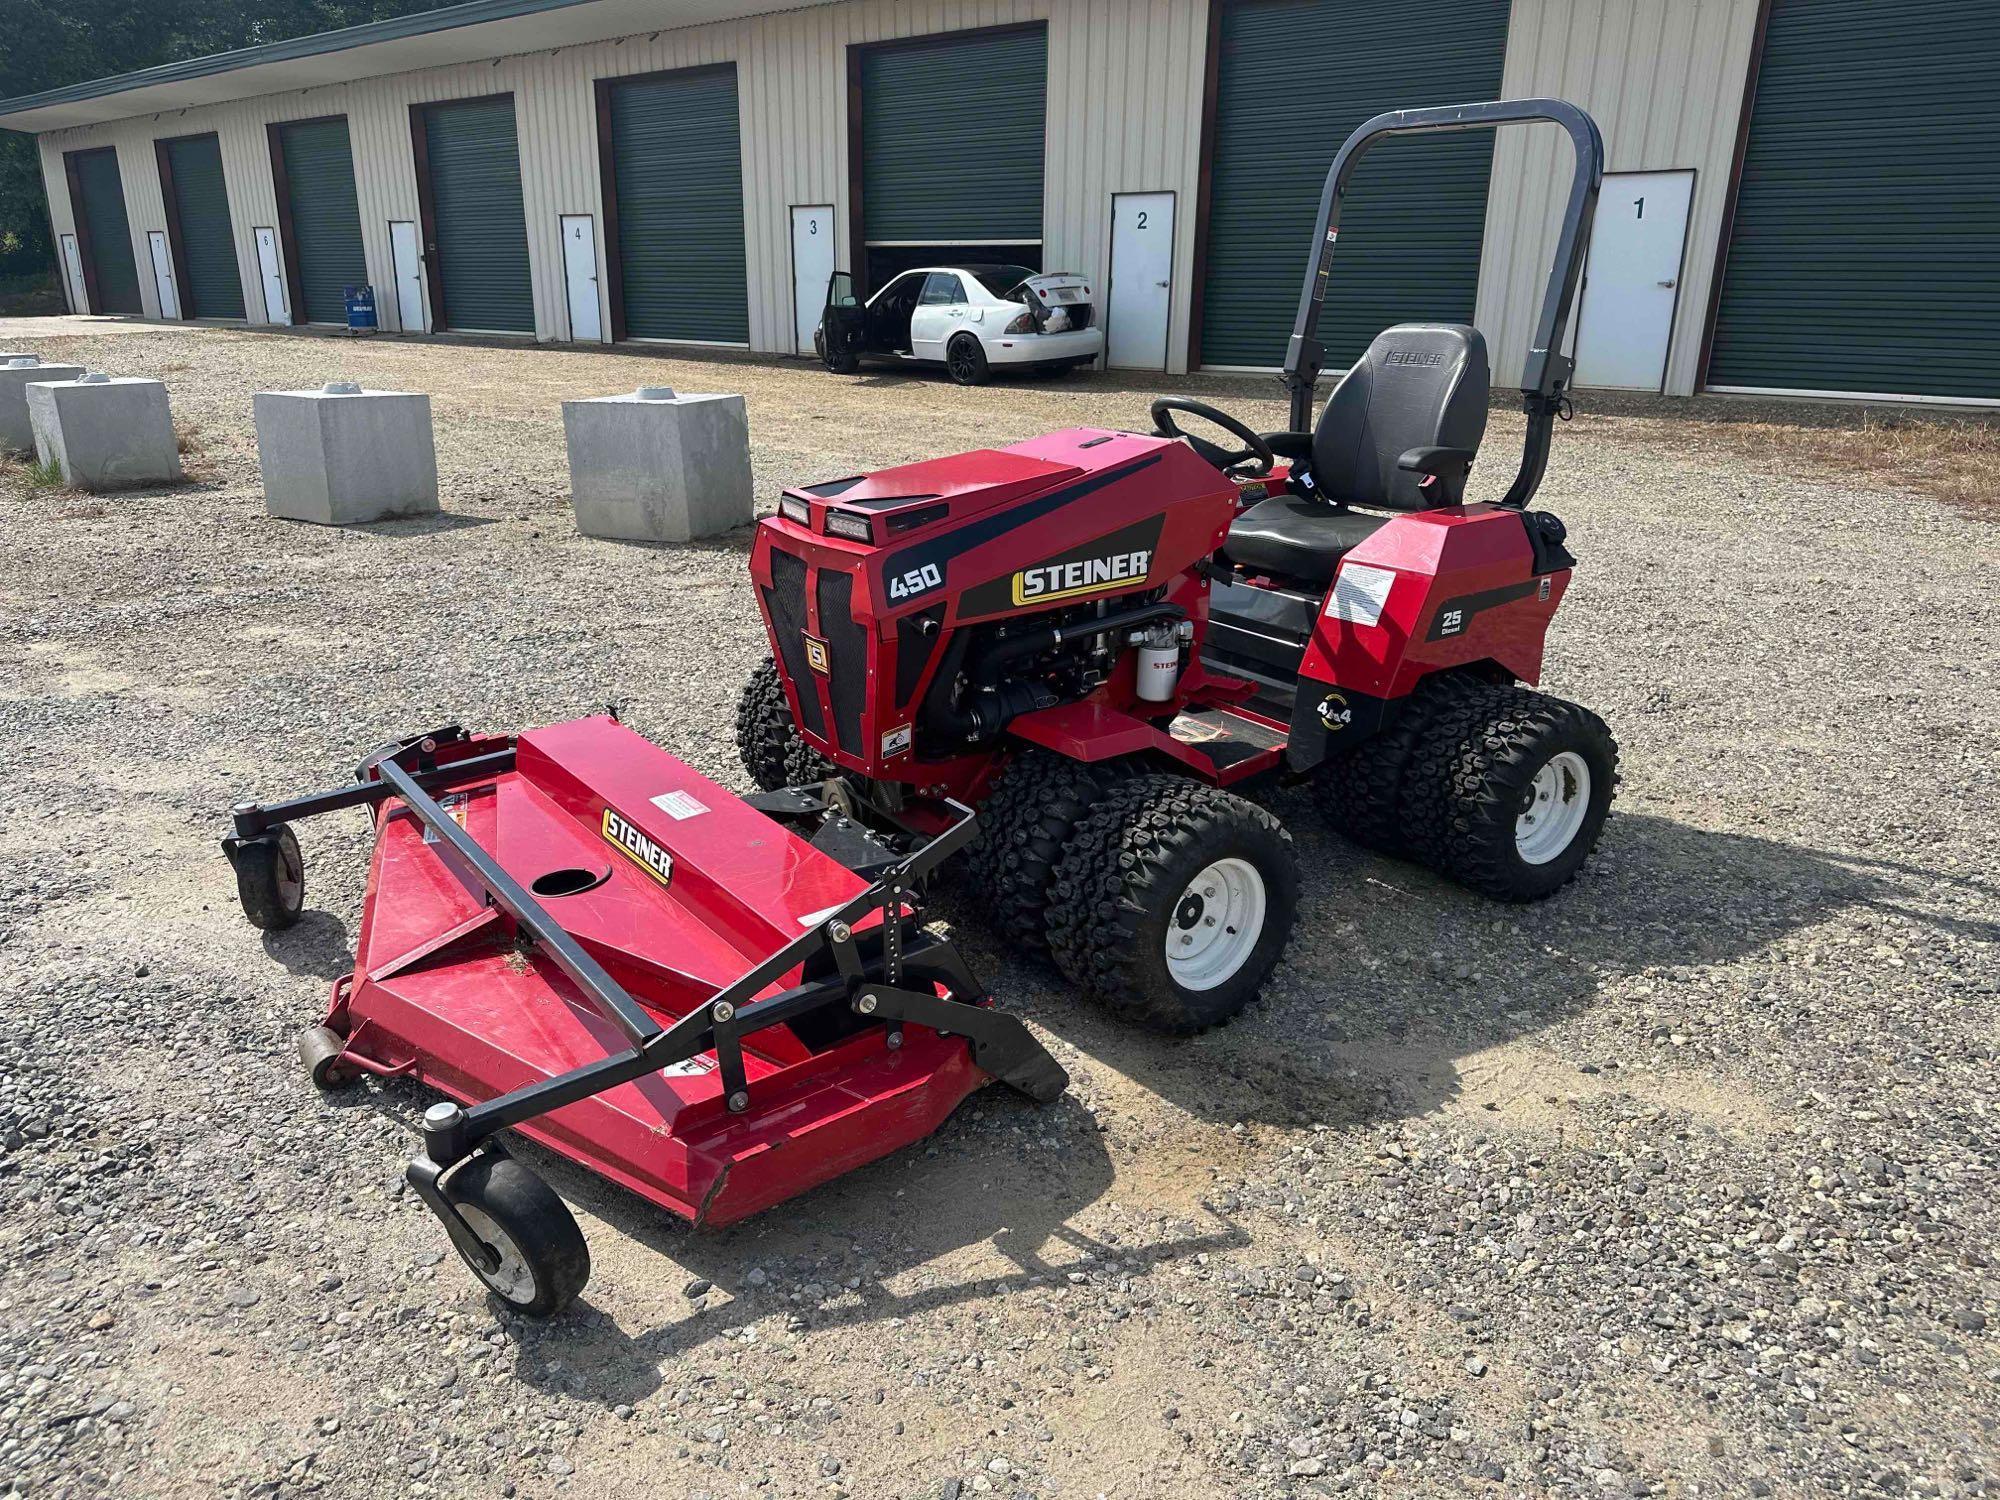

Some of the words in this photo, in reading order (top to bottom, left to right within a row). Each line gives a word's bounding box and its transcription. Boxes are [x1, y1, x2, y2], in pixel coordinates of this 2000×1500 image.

[1634, 197, 1644, 219] 1
[810, 219, 818, 235] 3
[1137, 211, 1148, 230] 2
[263, 235, 269, 246] 6
[575, 227, 581, 240] 4
[890, 563, 942, 600] 450
[1024, 550, 1148, 596] STEINER
[1442, 610, 1462, 628] 25
[812, 646, 822, 665] S
[607, 812, 672, 878] STEINER
